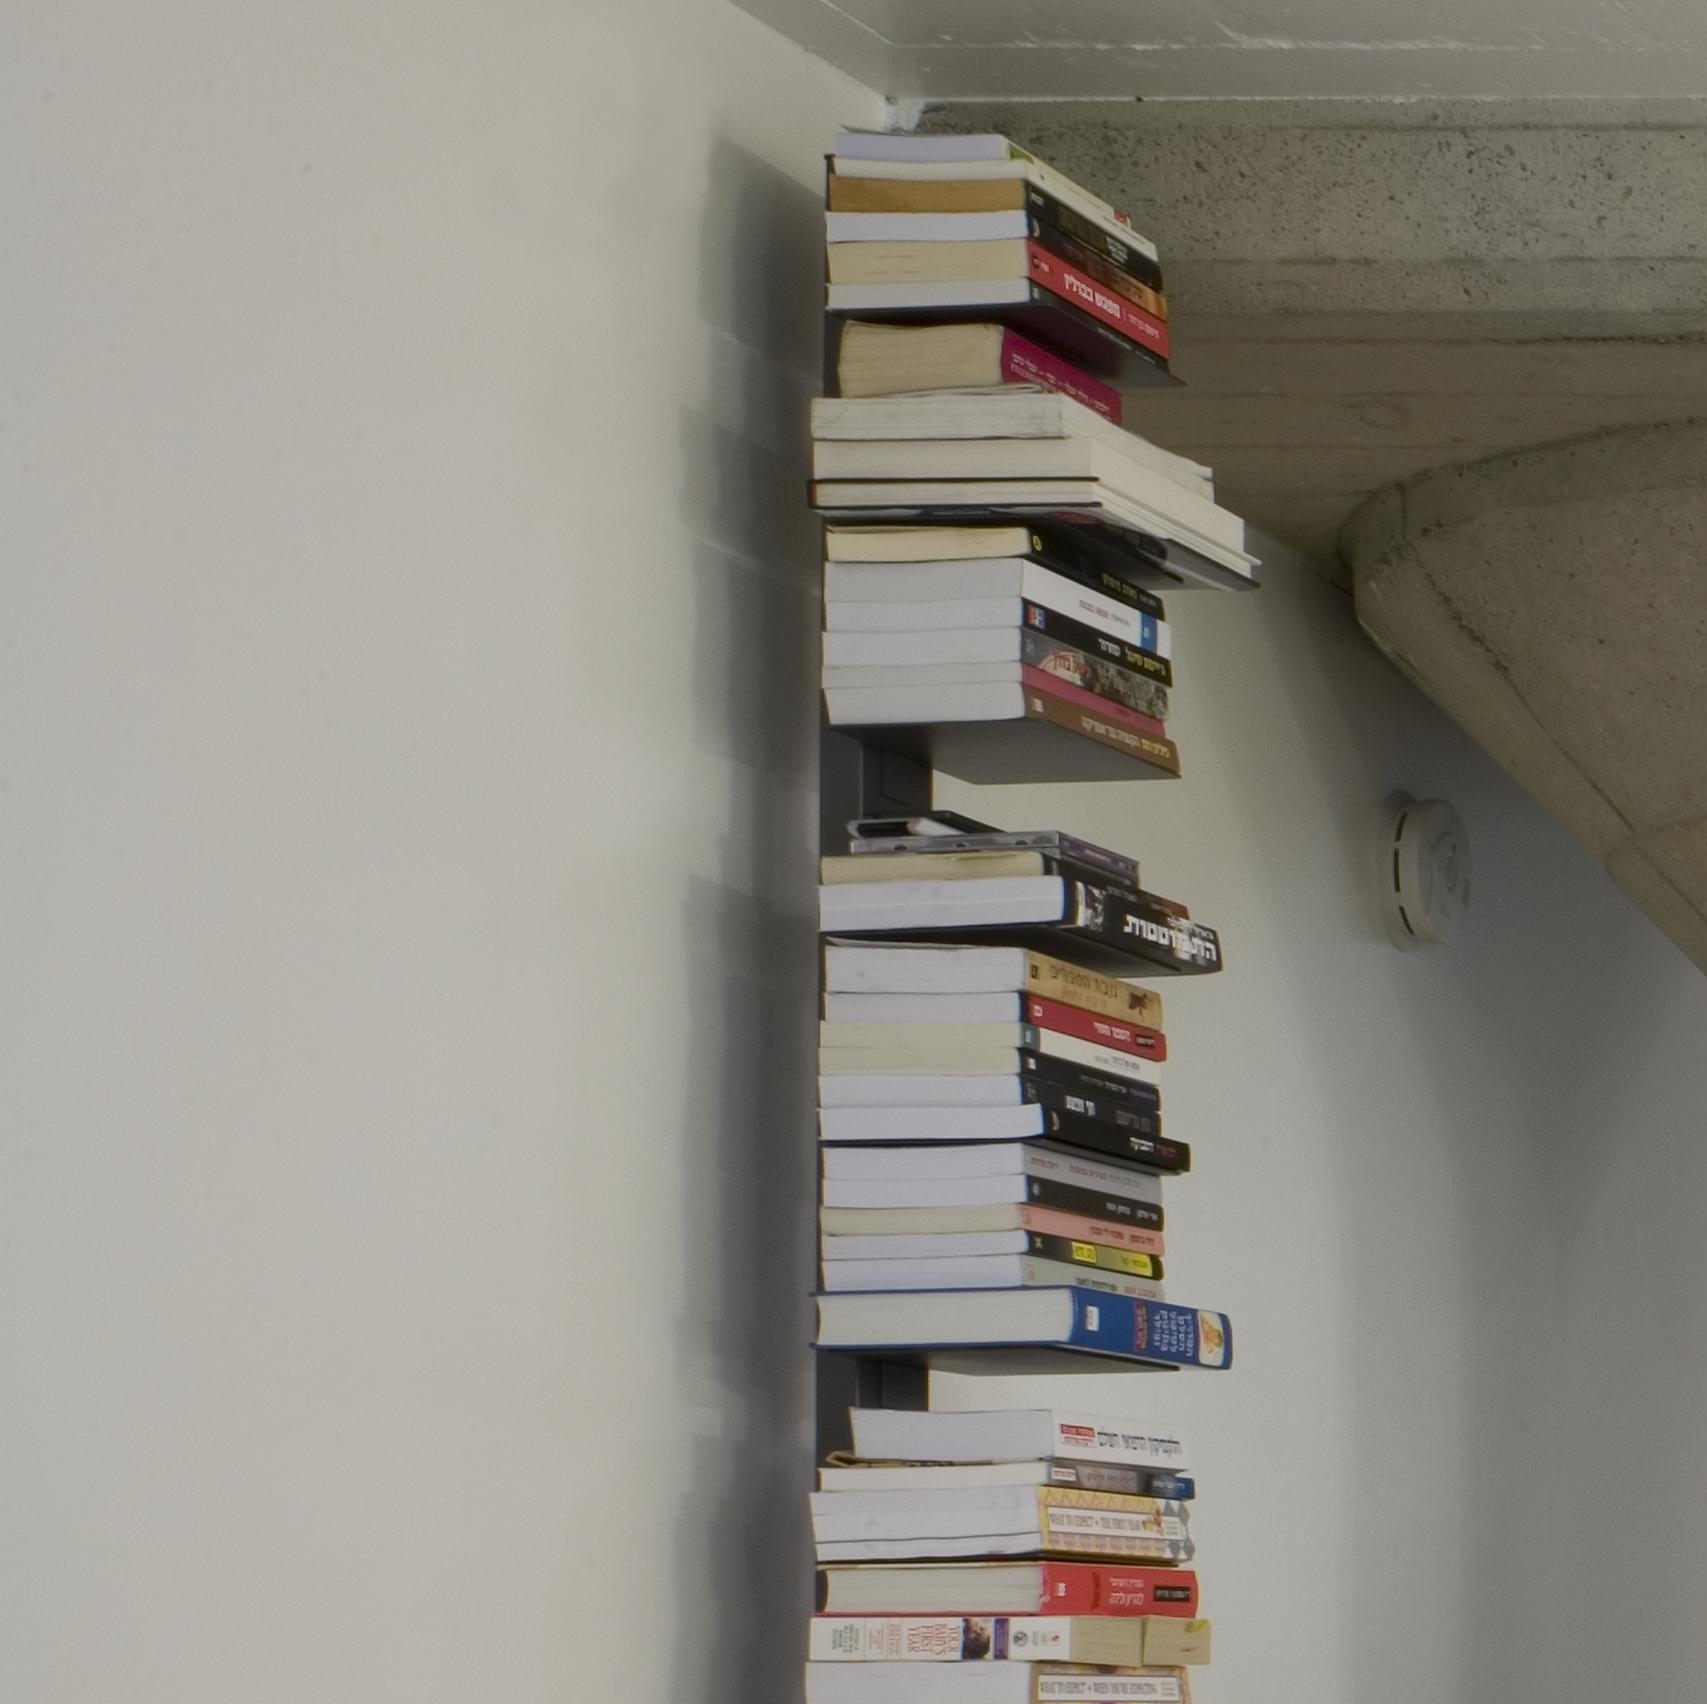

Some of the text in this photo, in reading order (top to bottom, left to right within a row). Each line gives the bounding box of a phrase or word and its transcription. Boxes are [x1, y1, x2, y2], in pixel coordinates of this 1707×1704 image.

[908, 1626, 920, 1652] YEAR
[920, 1625, 934, 1652] FIRST
[948, 1625, 960, 1653] YOUR
